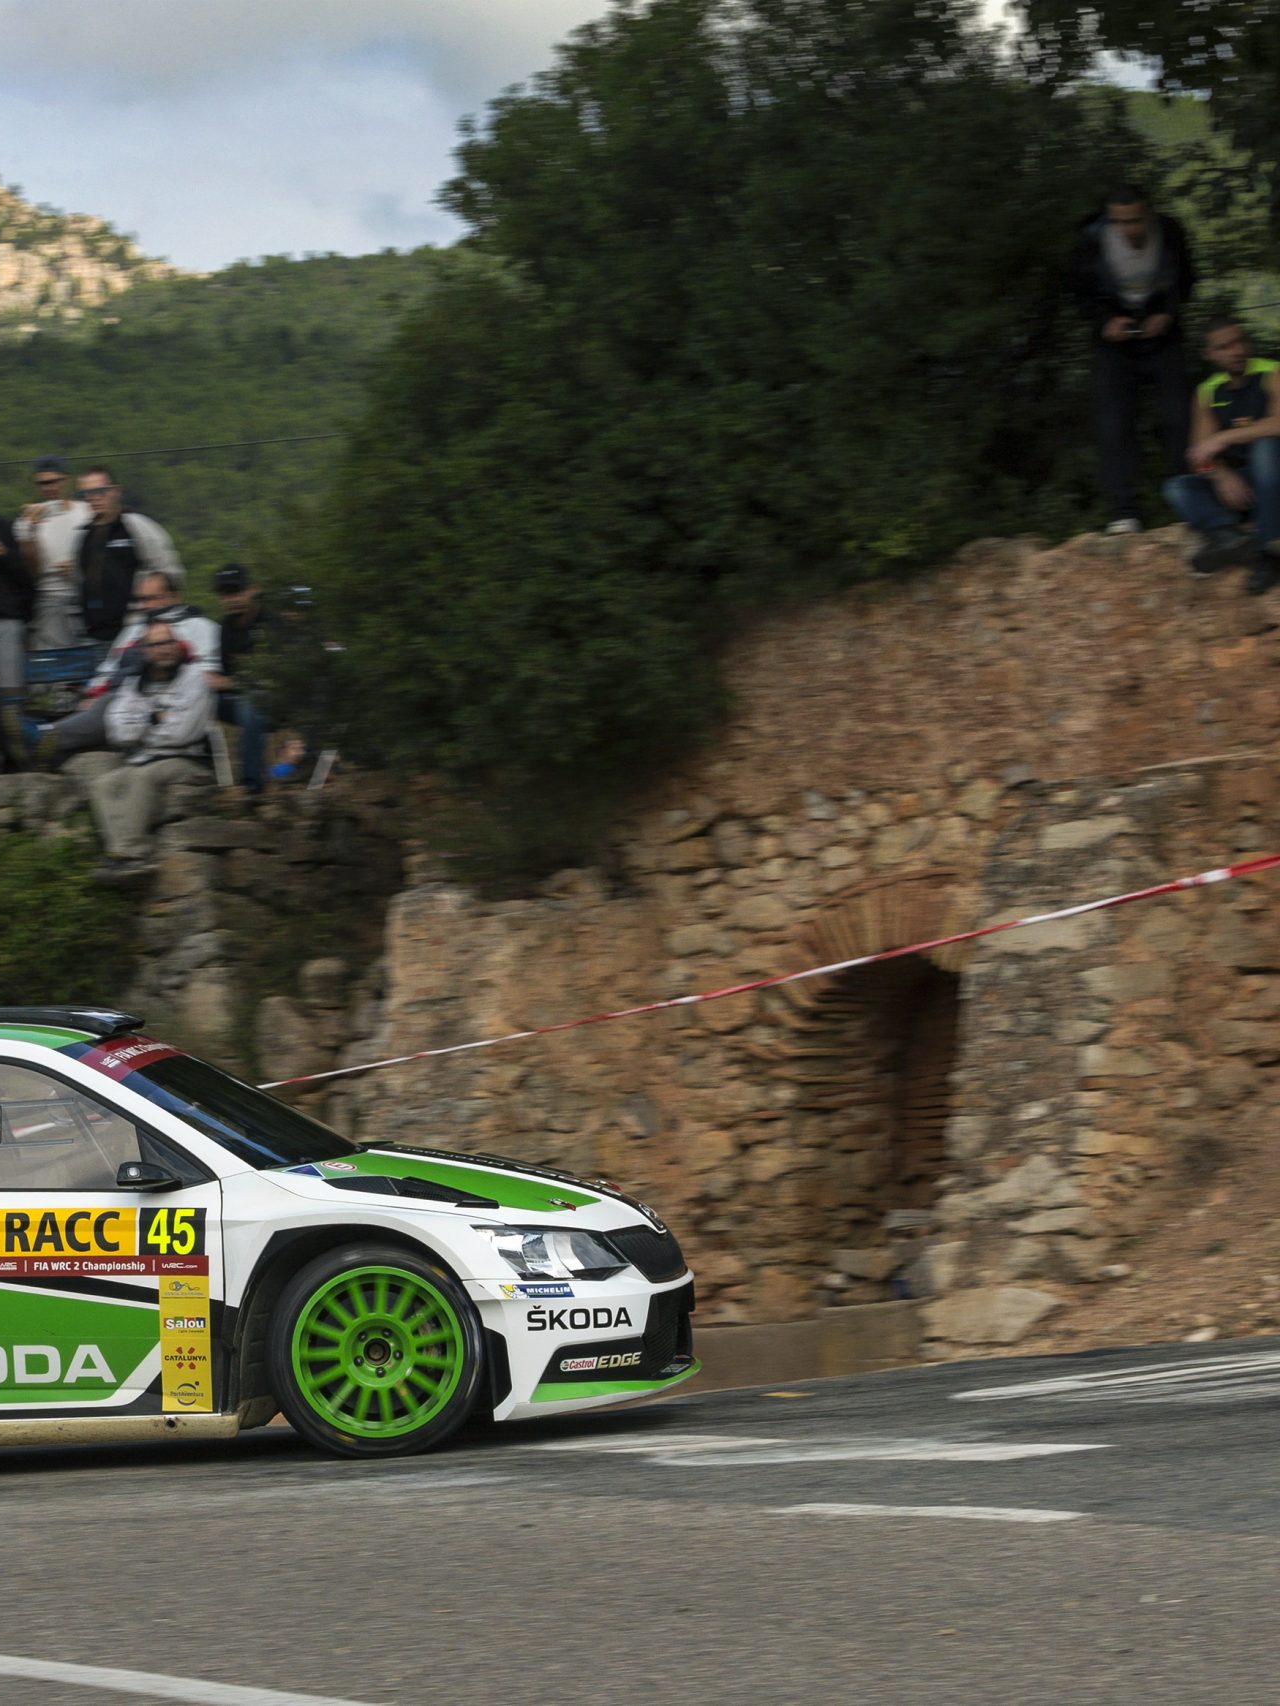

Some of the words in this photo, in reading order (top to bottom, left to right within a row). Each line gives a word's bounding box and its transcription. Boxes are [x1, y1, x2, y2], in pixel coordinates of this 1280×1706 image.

[4, 1210, 121, 1253] RACC
[146, 1208, 196, 1255] 45
[33, 1261, 49, 1271] FIA
[51, 1261, 72, 1271] WRC
[73, 1261, 80, 1271] 2
[82, 1261, 146, 1272] Championship
[526, 1286, 571, 1294] MICHELIN
[165, 1318, 205, 1330] Salou
[526, 1305, 633, 1331] ŠKODA
[568, 1358, 595, 1370] Castrol
[597, 1351, 642, 1369] EDGE
